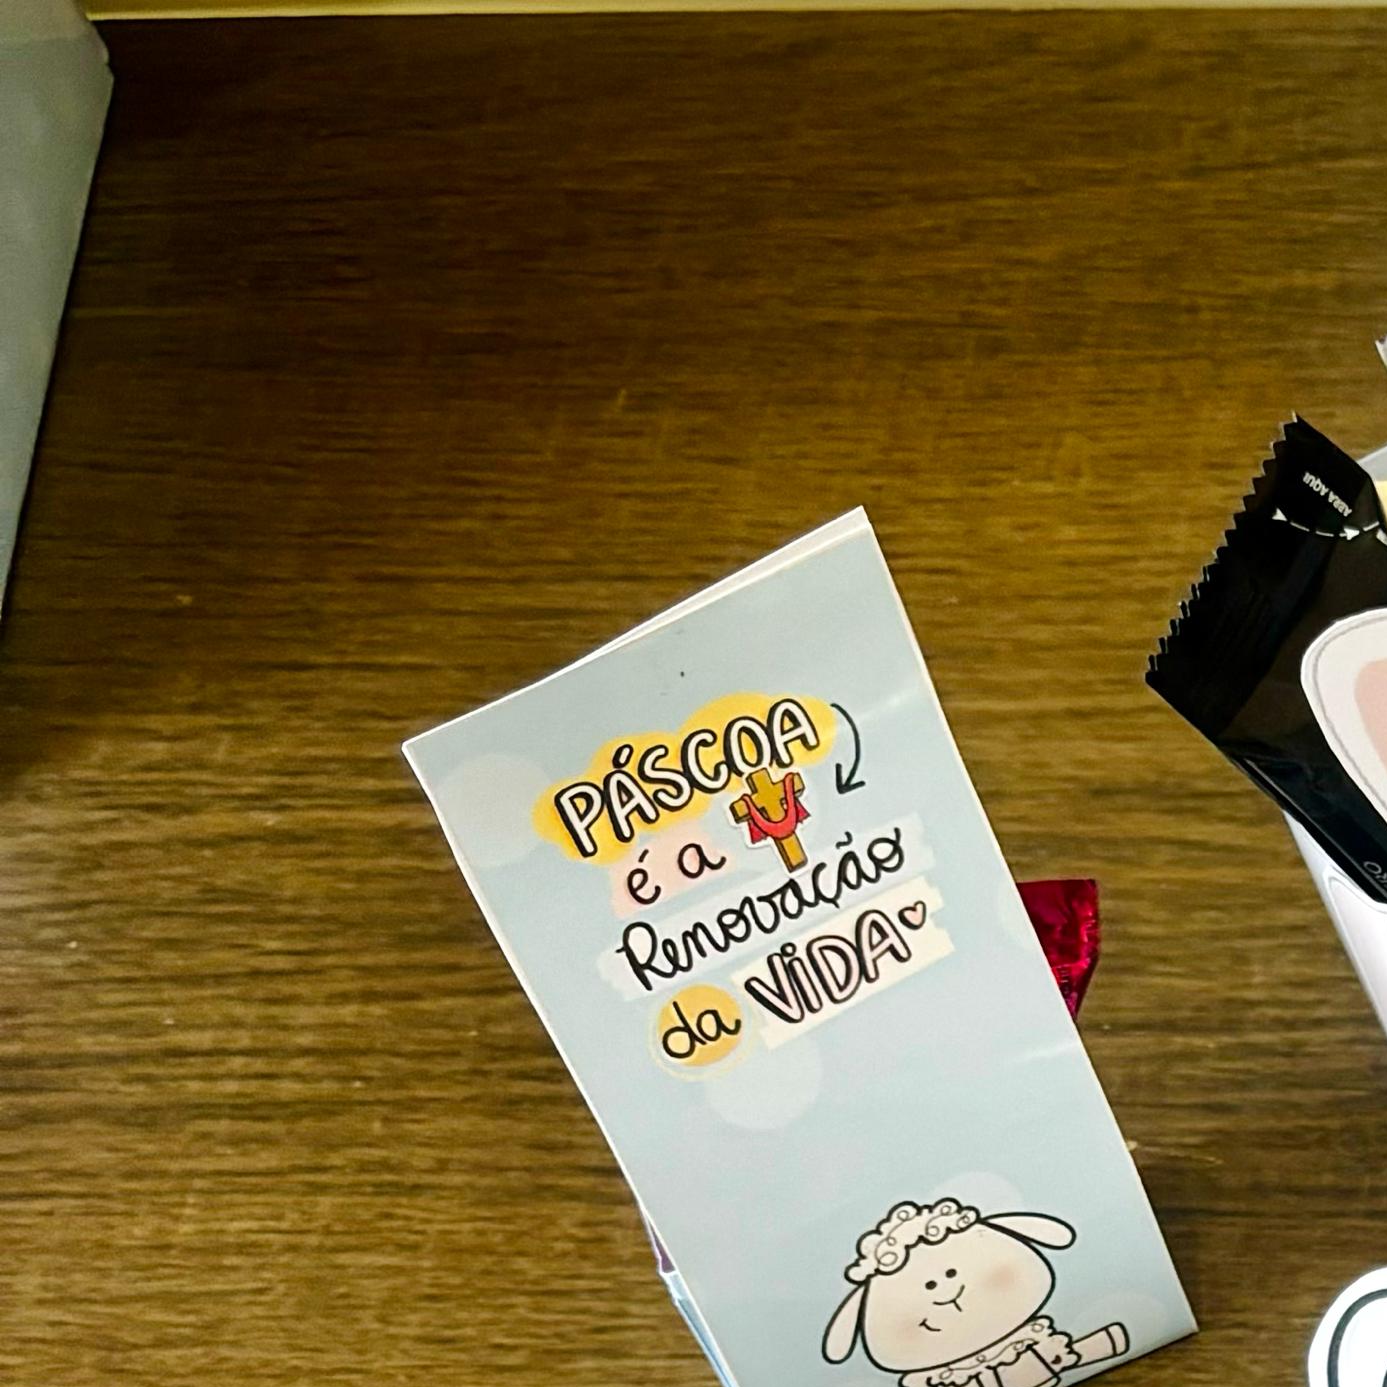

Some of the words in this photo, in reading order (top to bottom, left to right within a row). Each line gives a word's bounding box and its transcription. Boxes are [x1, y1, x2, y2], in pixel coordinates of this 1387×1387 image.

[1302, 471, 1330, 496] AQUI
[1327, 490, 1353, 517] ABRA
[553, 697, 820, 858] PÁSCOA
[626, 852, 662, 906] é
[677, 842, 727, 882] a
[615, 826, 907, 991] Renovação
[660, 1000, 742, 1062] da
